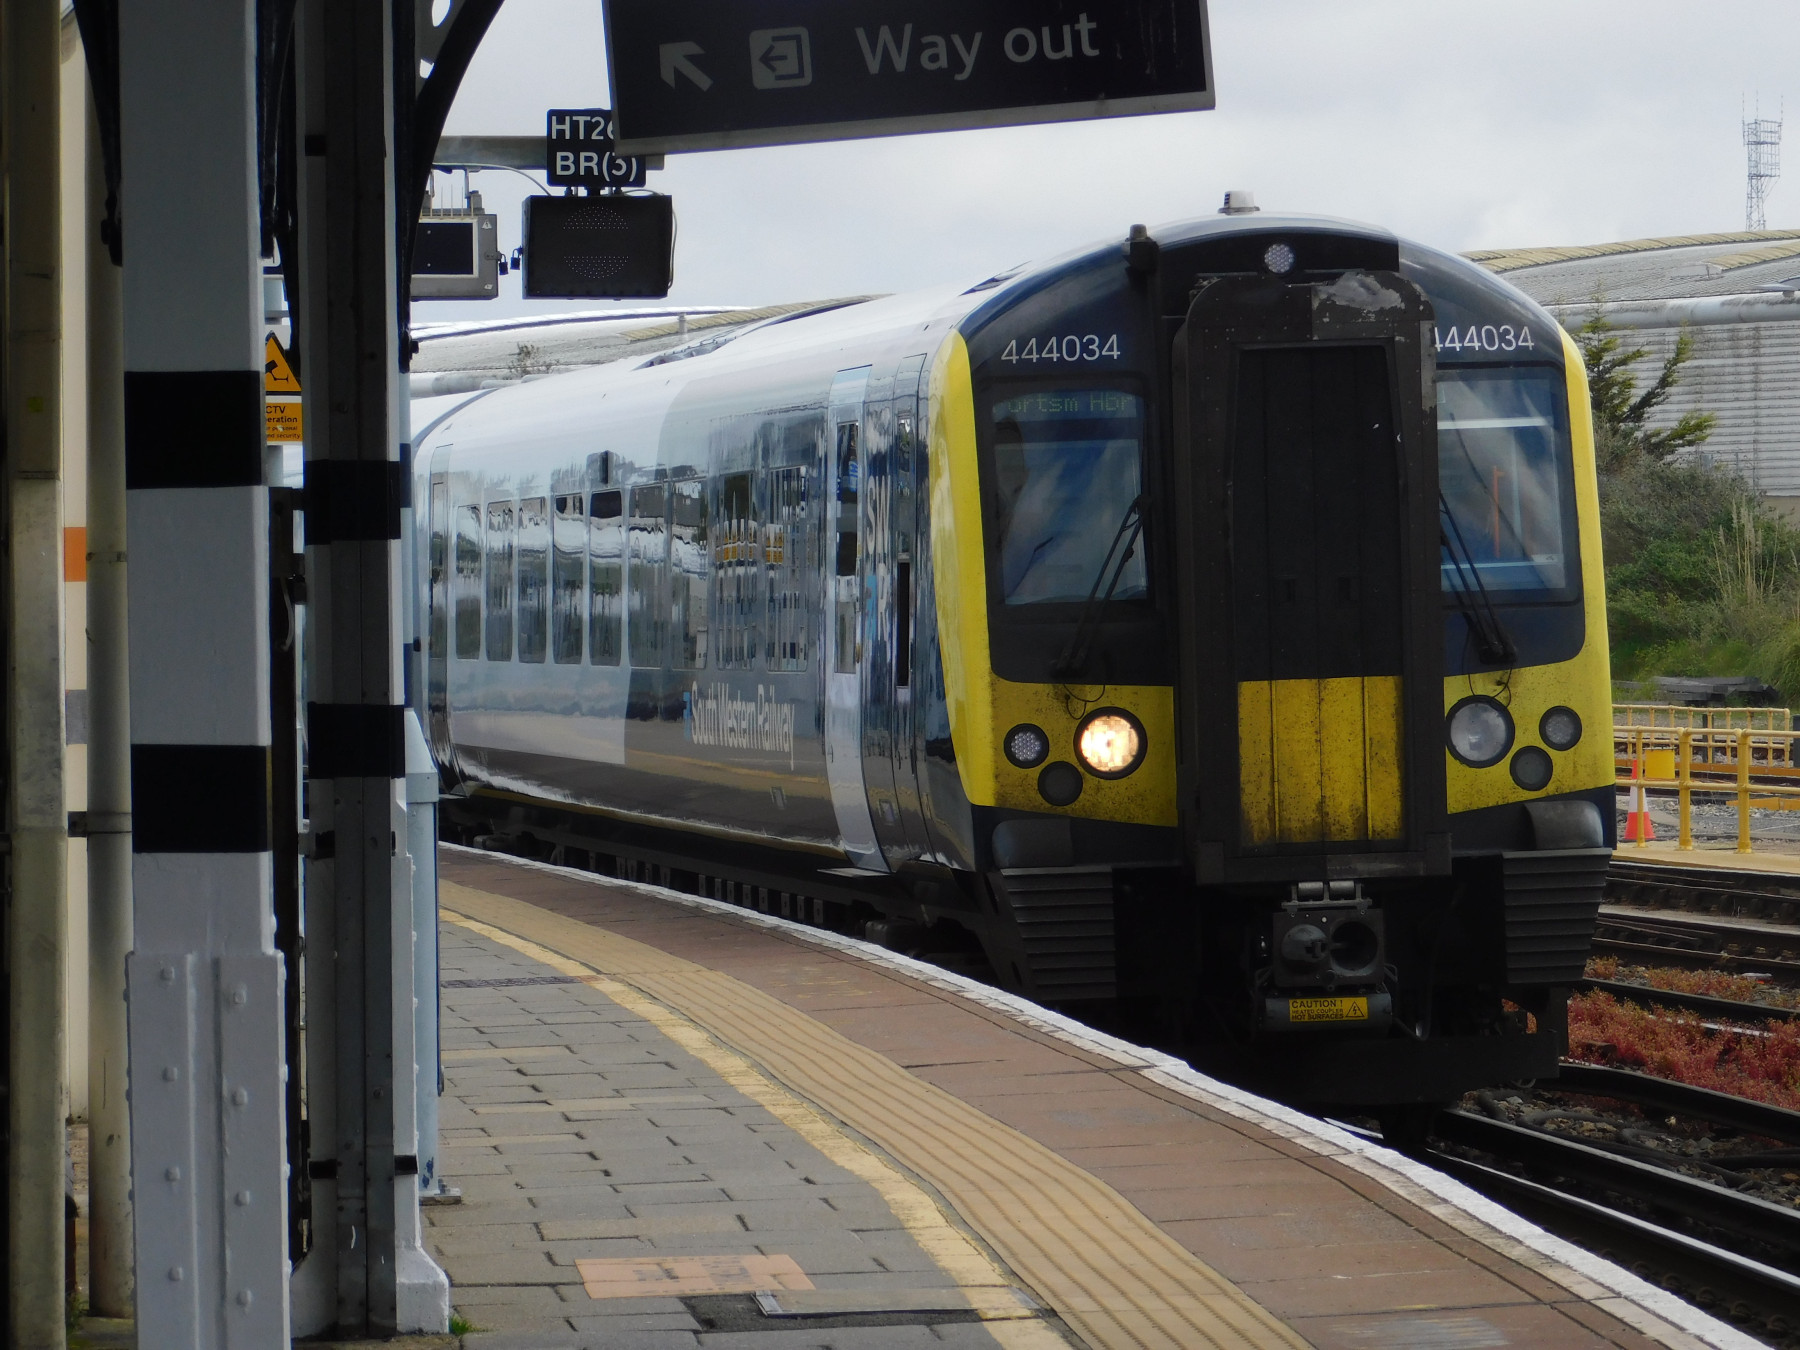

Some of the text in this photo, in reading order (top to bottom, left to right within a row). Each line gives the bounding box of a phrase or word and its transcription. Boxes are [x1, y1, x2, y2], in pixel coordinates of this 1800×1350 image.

[854, 12, 1100, 81] Way out
[556, 152, 637, 182] BR(3)
[1001, 334, 1121, 364] 444034
[266, 405, 286, 414] CTV
[691, 681, 795, 771] South Western Railway
[1291, 1000, 1337, 1009] CAUTION
